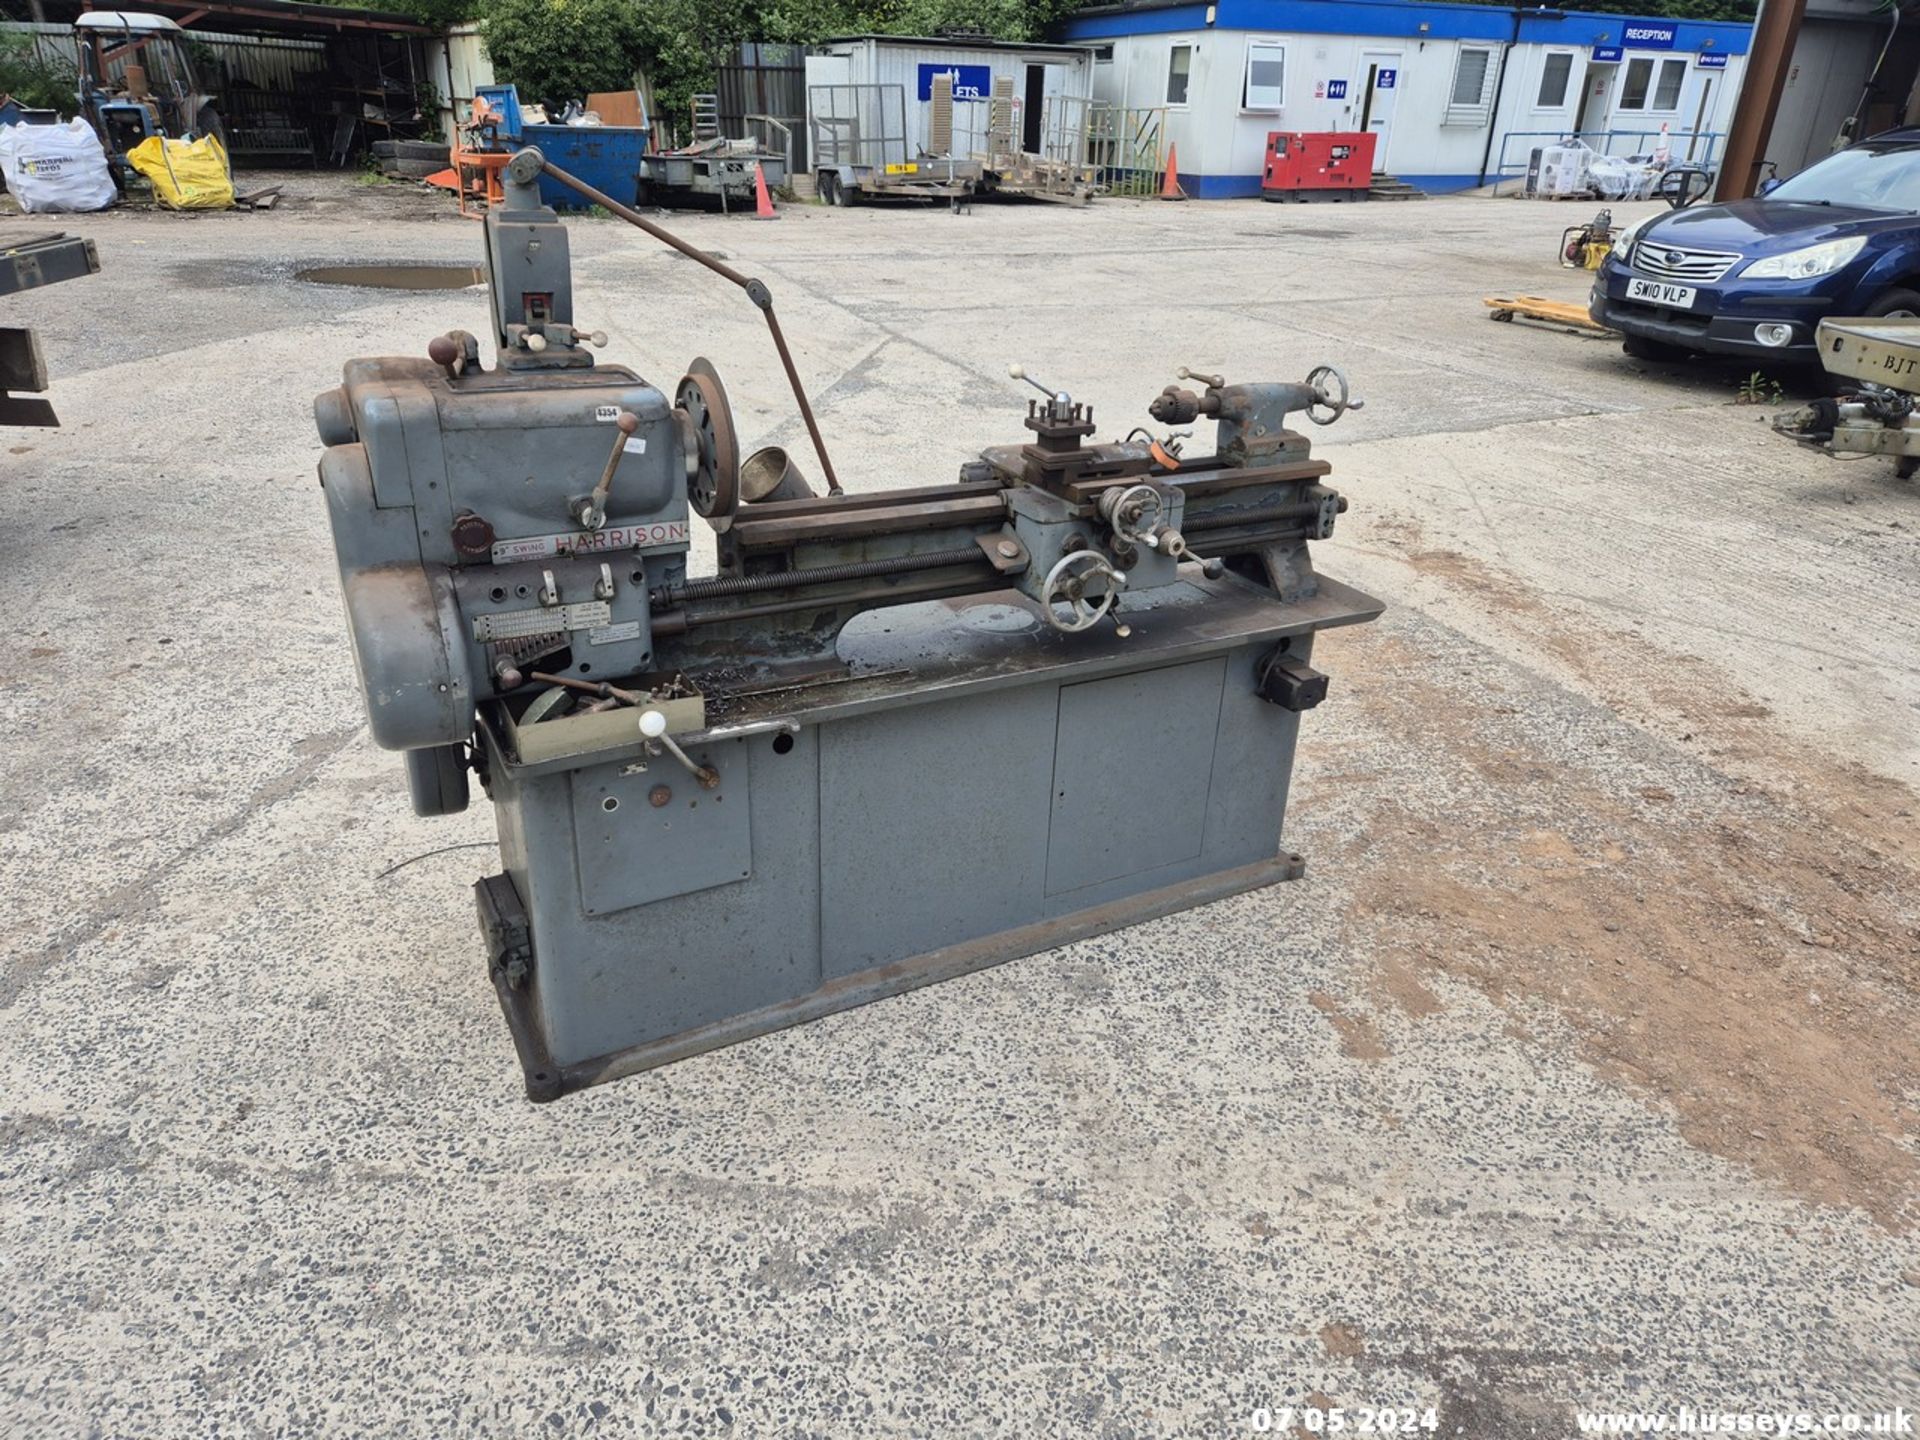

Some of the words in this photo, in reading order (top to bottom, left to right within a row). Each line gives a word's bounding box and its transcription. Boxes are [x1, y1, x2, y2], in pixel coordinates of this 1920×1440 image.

[1625, 28, 1673, 41] RECEPTION
[1634, 281, 1661, 299] SW10
[1663, 286, 1688, 303] VLP
[1884, 355, 1918, 374] BJT
[598, 408, 617, 417] 4354
[513, 543, 545, 554] SWING
[555, 524, 684, 550] HARRISON
